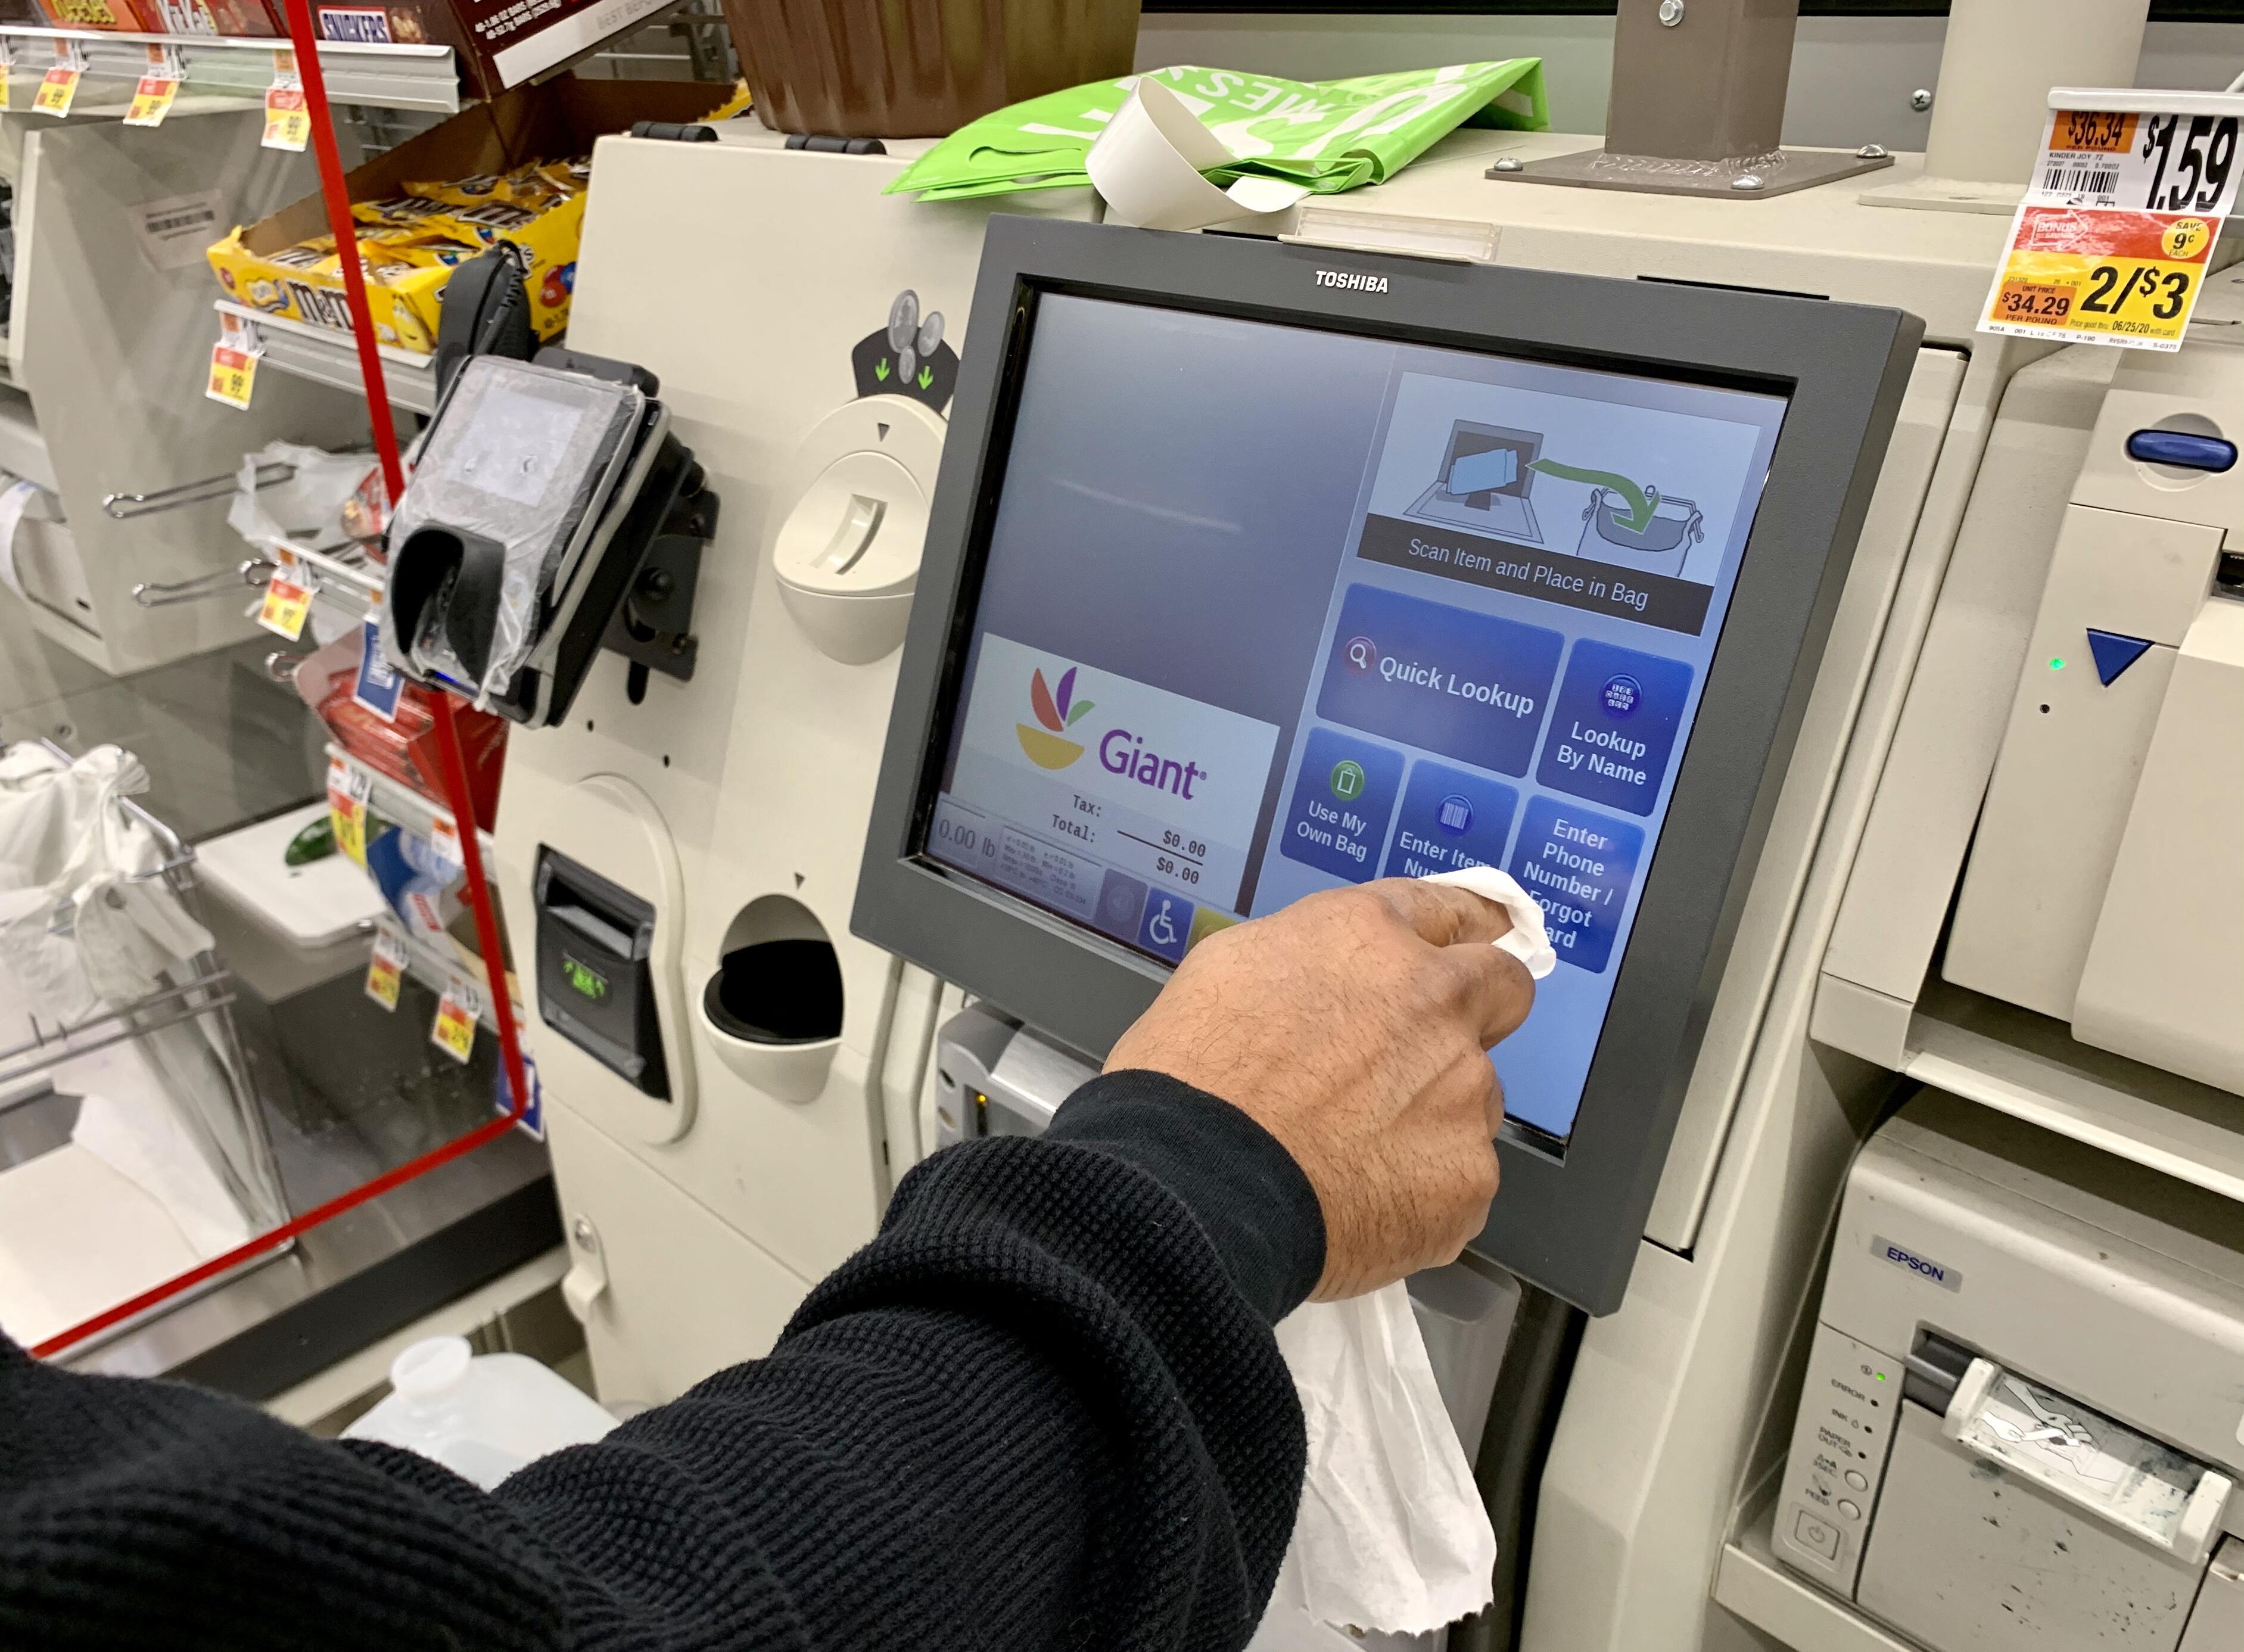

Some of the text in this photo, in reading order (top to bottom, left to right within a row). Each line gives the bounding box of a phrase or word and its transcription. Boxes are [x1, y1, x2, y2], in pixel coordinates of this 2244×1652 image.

[2068, 111, 2126, 146] $36.34
[2143, 114, 2239, 213] $1.59
[2175, 221, 2203, 232] SAVE
[1316, 270, 1388, 293] TOSHIBA
[2002, 292, 2070, 316] $34.29
[2025, 316, 2058, 325] POUND
[2112, 321, 2150, 334] 06/25/20
[1409, 538, 1649, 611] Scan Item and Place in Bag
[1379, 656, 1535, 718] Quick Lookup
[1571, 721, 1647, 760] Lookup
[1099, 729, 1197, 800] Giant
[1557, 745, 1647, 785] By Name
[1073, 795, 1101, 817] Tax:
[1308, 800, 1367, 836] Use My
[939, 819, 976, 850] 0.00
[982, 838, 995, 858] lb
[1052, 814, 1095, 843] Total:
[1297, 822, 1368, 861] Own Bag
[1553, 819, 1608, 851] Enter
[1162, 830, 1206, 858] $0.00
[1400, 832, 1447, 861] Enter
[1156, 857, 1200, 885] $0.00
[1543, 843, 1605, 876] Phone
[1524, 861, 1601, 902] Number
[1545, 922, 1576, 948] ard
[1887, 1246, 1944, 1281] EPSON
[1831, 1379, 1865, 1401] ERROR
[1832, 1408, 1847, 1421] INK
[1819, 1433, 1837, 1448] OUT
[1820, 1426, 1851, 1447] PAPER
